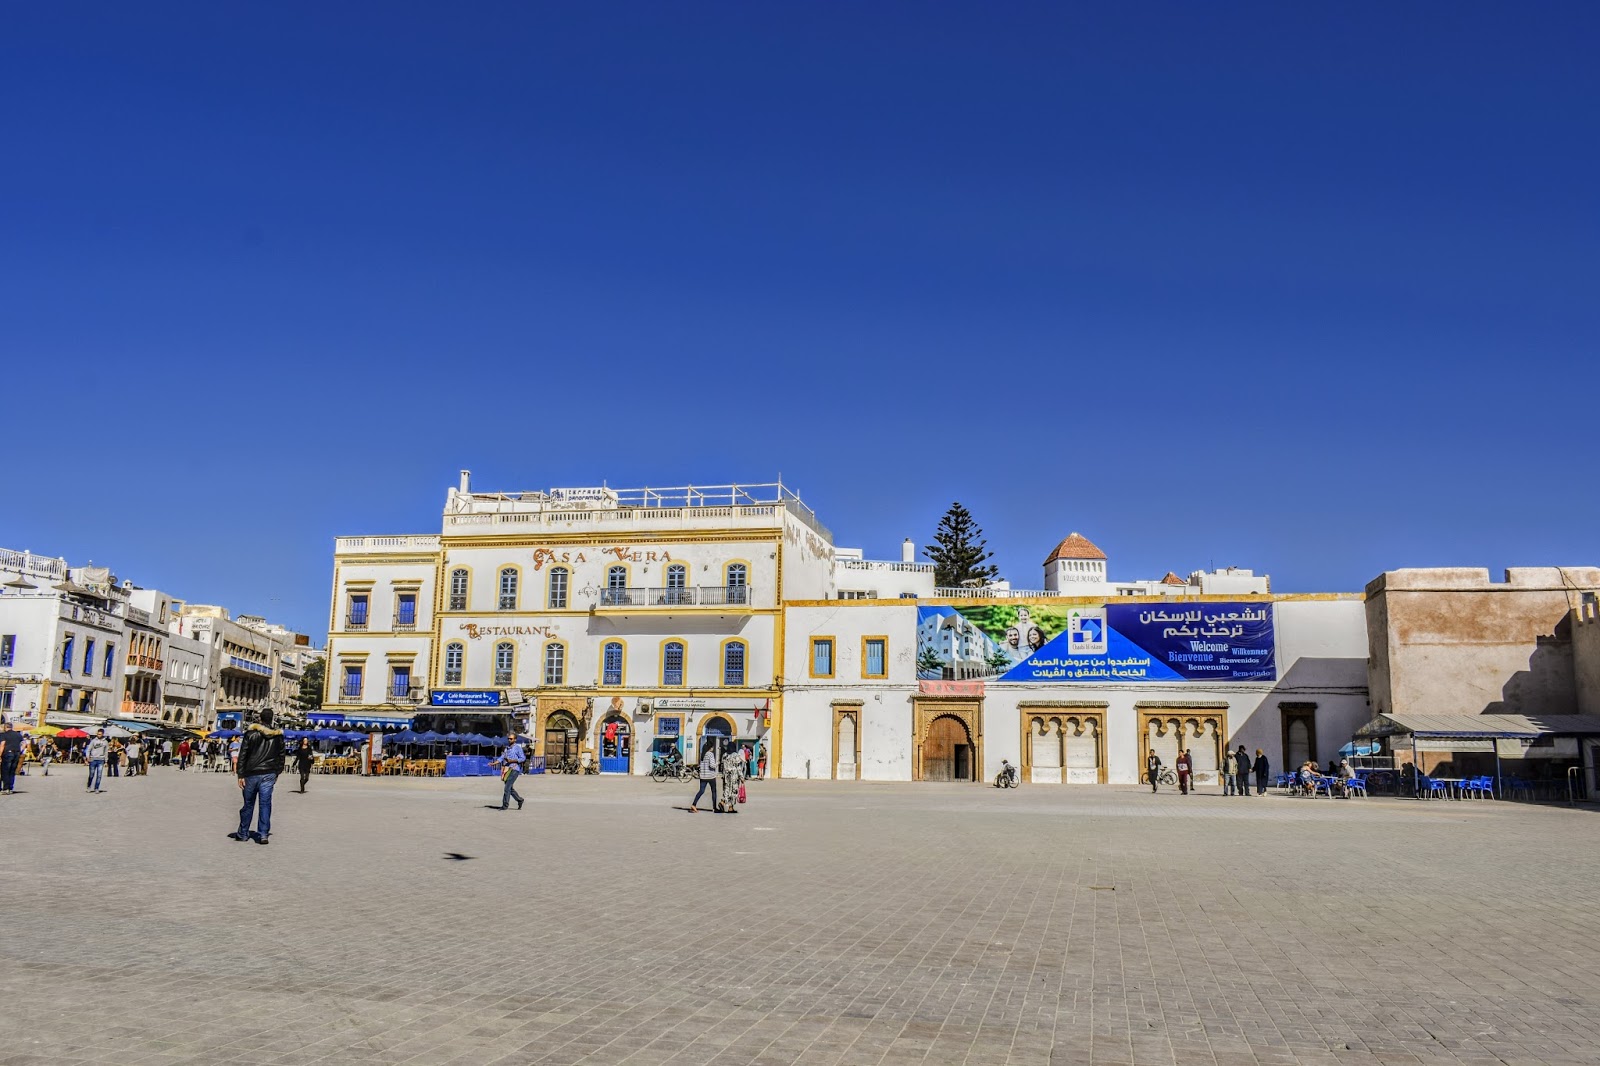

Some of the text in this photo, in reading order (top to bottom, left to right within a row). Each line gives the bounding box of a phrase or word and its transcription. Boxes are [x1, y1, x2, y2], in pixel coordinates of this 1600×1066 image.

[602, 547, 672, 564] VERA
[1139, 608, 1266, 626] الشعبي للإسكان
[460, 623, 557, 640] RESTAURANT
[1163, 624, 1244, 638] ترحب بكم
[1190, 640, 1229, 652] Welcome
[1231, 647, 1268, 656] Willkommen
[1028, 657, 1151, 667] إستفيدوا من عروض الصيف
[1168, 651, 1214, 662] Bienvenue
[1067, 670, 1073, 678] و
[1074, 668, 1110, 678] بالشقق
[1111, 668, 1146, 677] الخاصة
